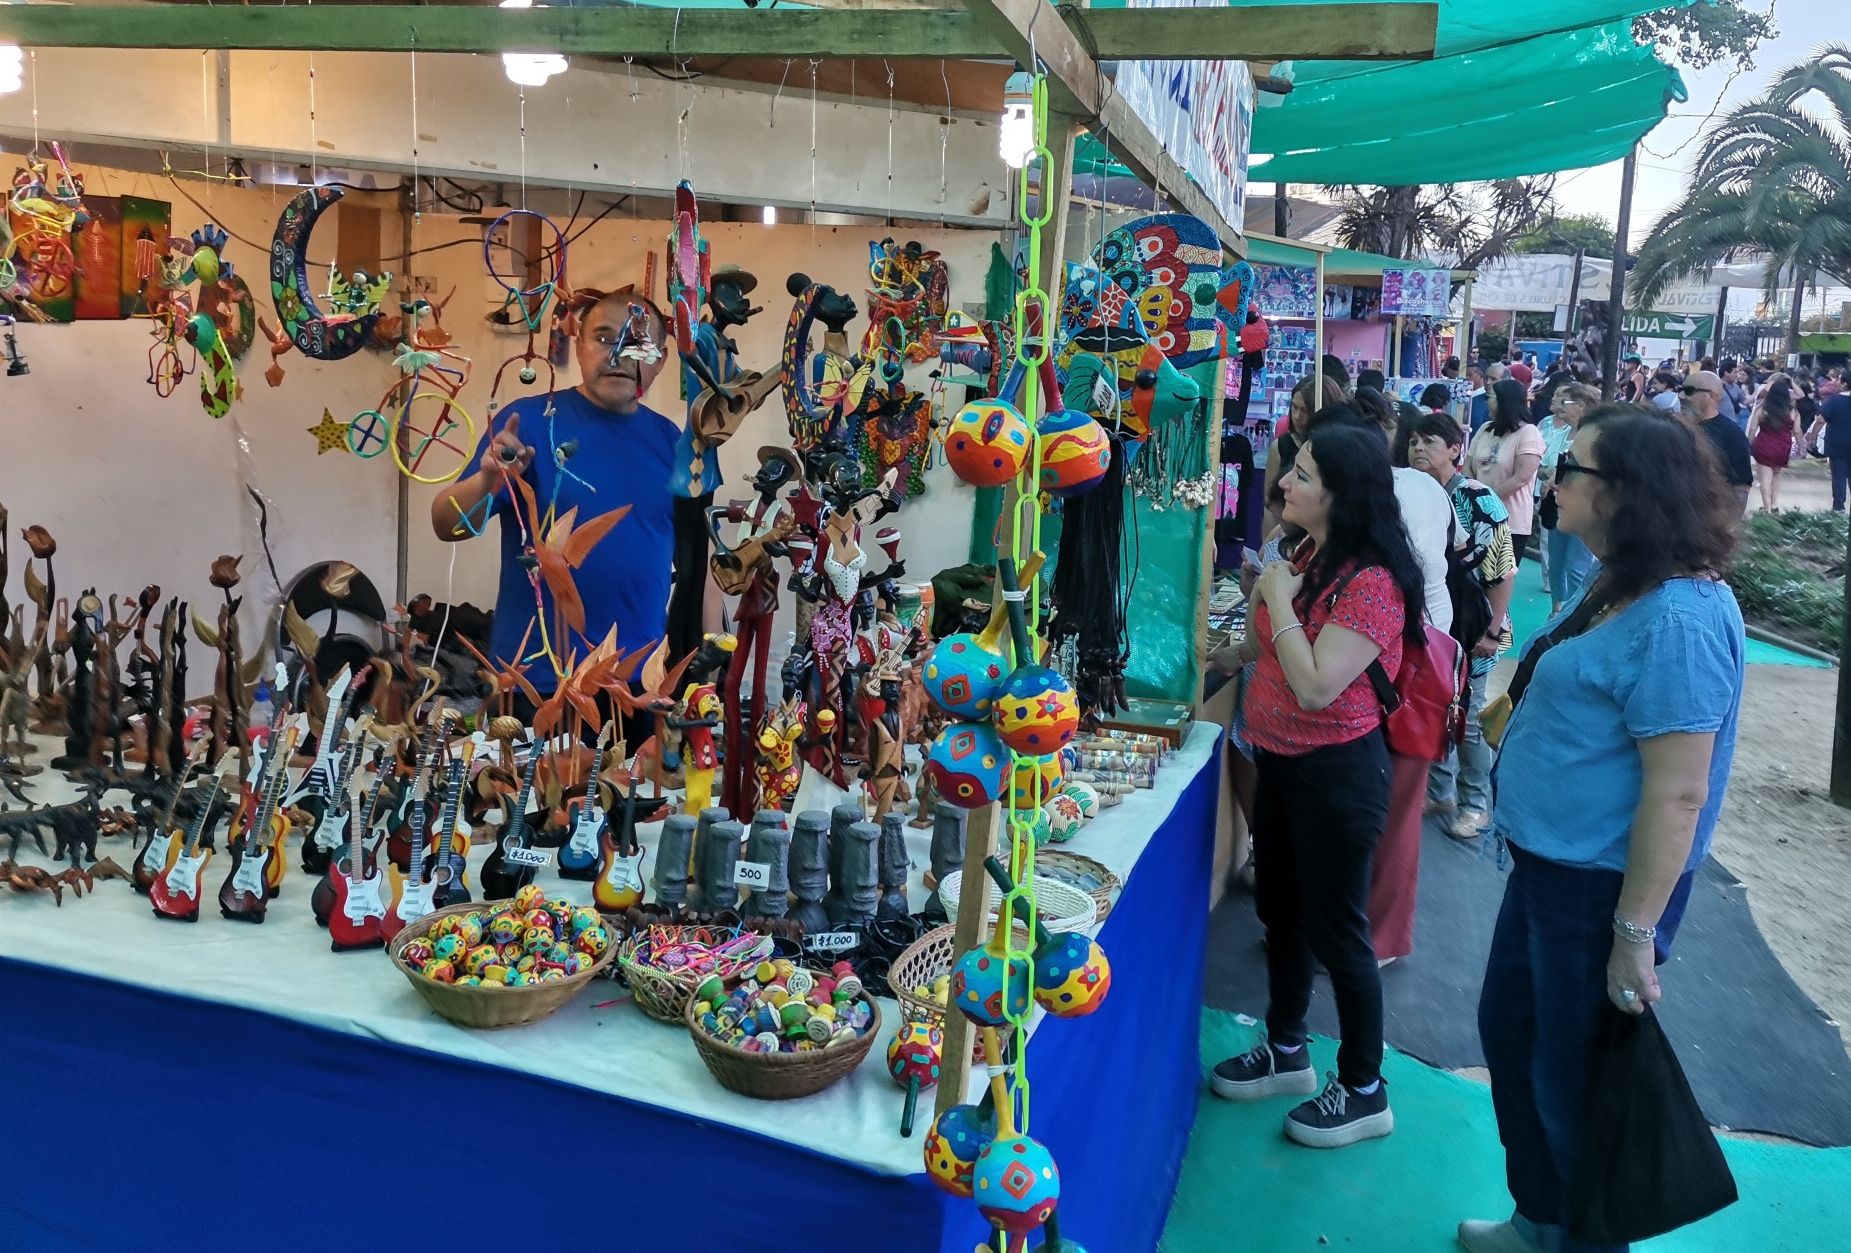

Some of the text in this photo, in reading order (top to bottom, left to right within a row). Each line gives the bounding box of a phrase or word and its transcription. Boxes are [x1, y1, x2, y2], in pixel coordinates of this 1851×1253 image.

[1620, 315, 1661, 333] LIDA
[739, 867, 762, 880] 500
[818, 935, 852, 947] $1.000
